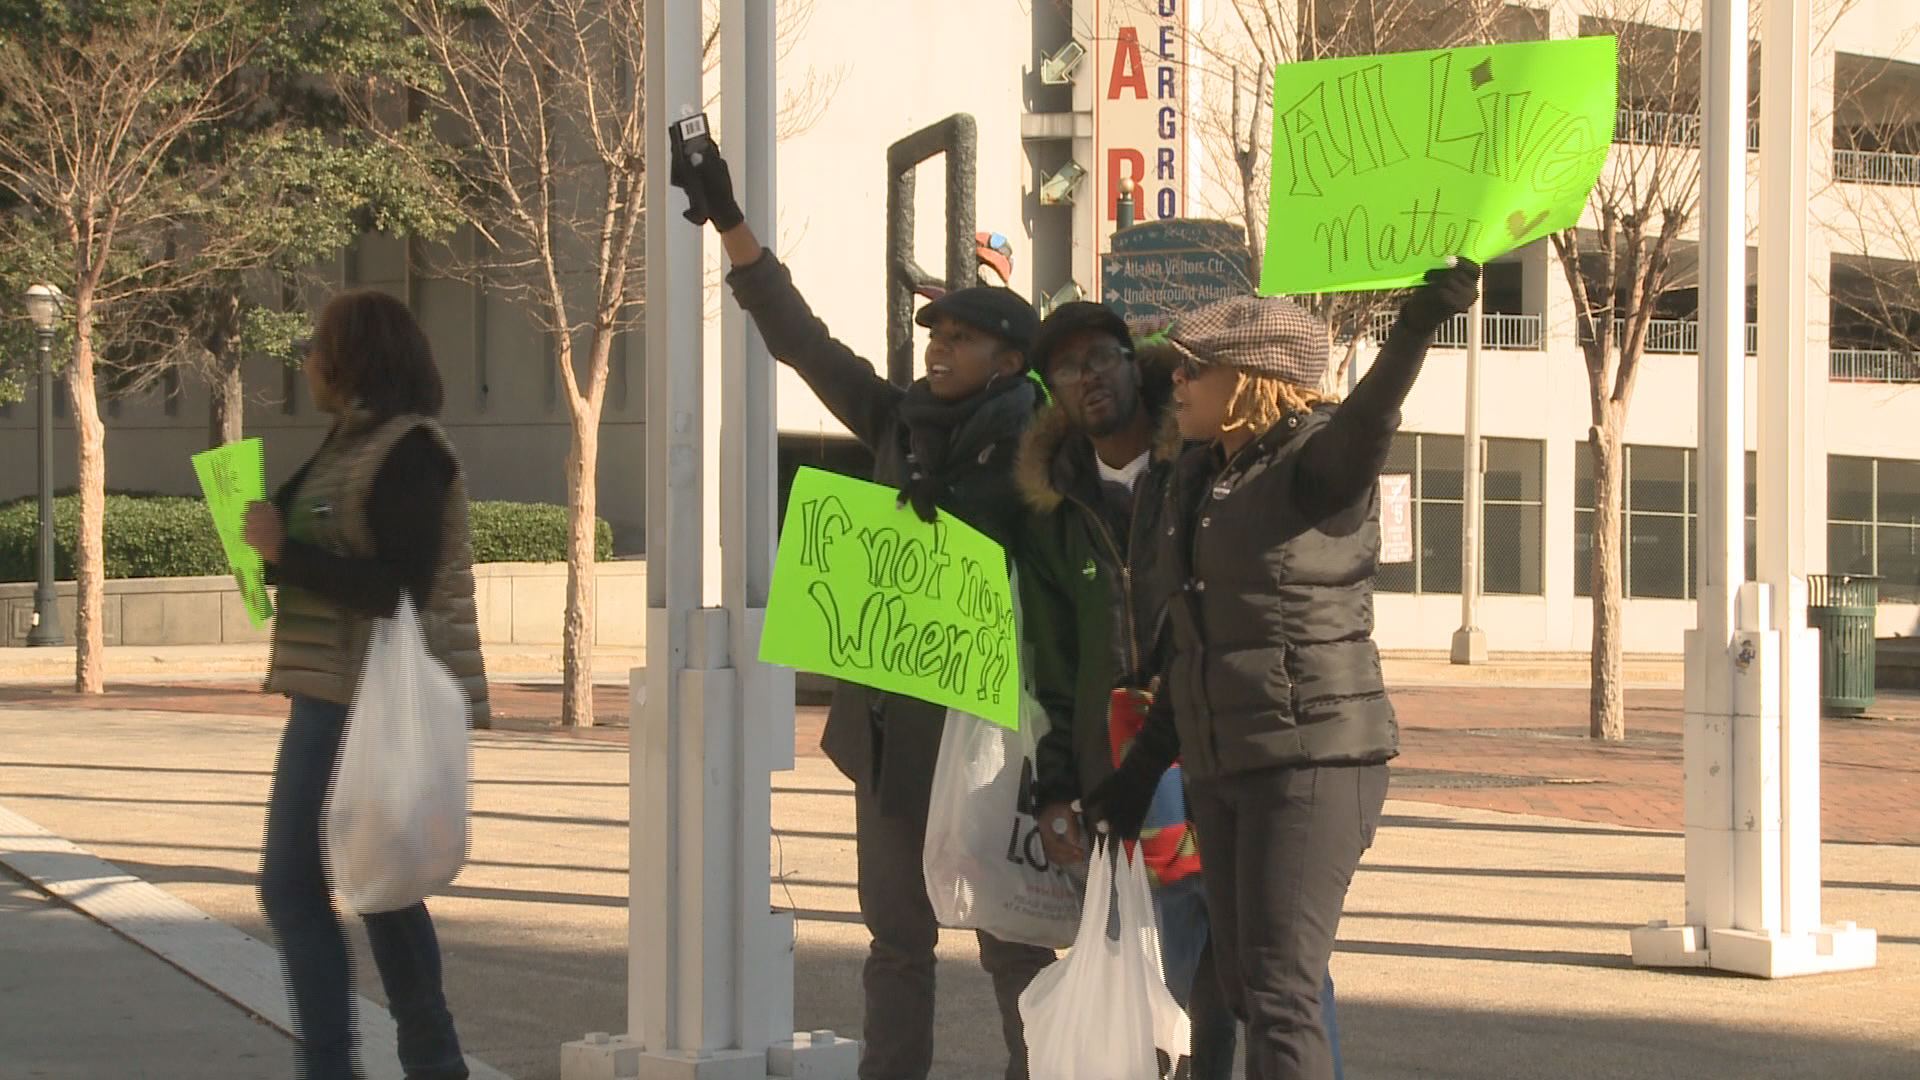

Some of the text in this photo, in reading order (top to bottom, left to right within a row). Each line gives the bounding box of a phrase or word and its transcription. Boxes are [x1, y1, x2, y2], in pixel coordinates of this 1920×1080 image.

[1281, 64, 1411, 197] All
[1124, 260, 1163, 277] Atlanta
[1165, 259, 1206, 276] Visitors
[1124, 286, 1196, 306] Underground
[800, 495, 852, 573] If
[857, 520, 951, 599] not
